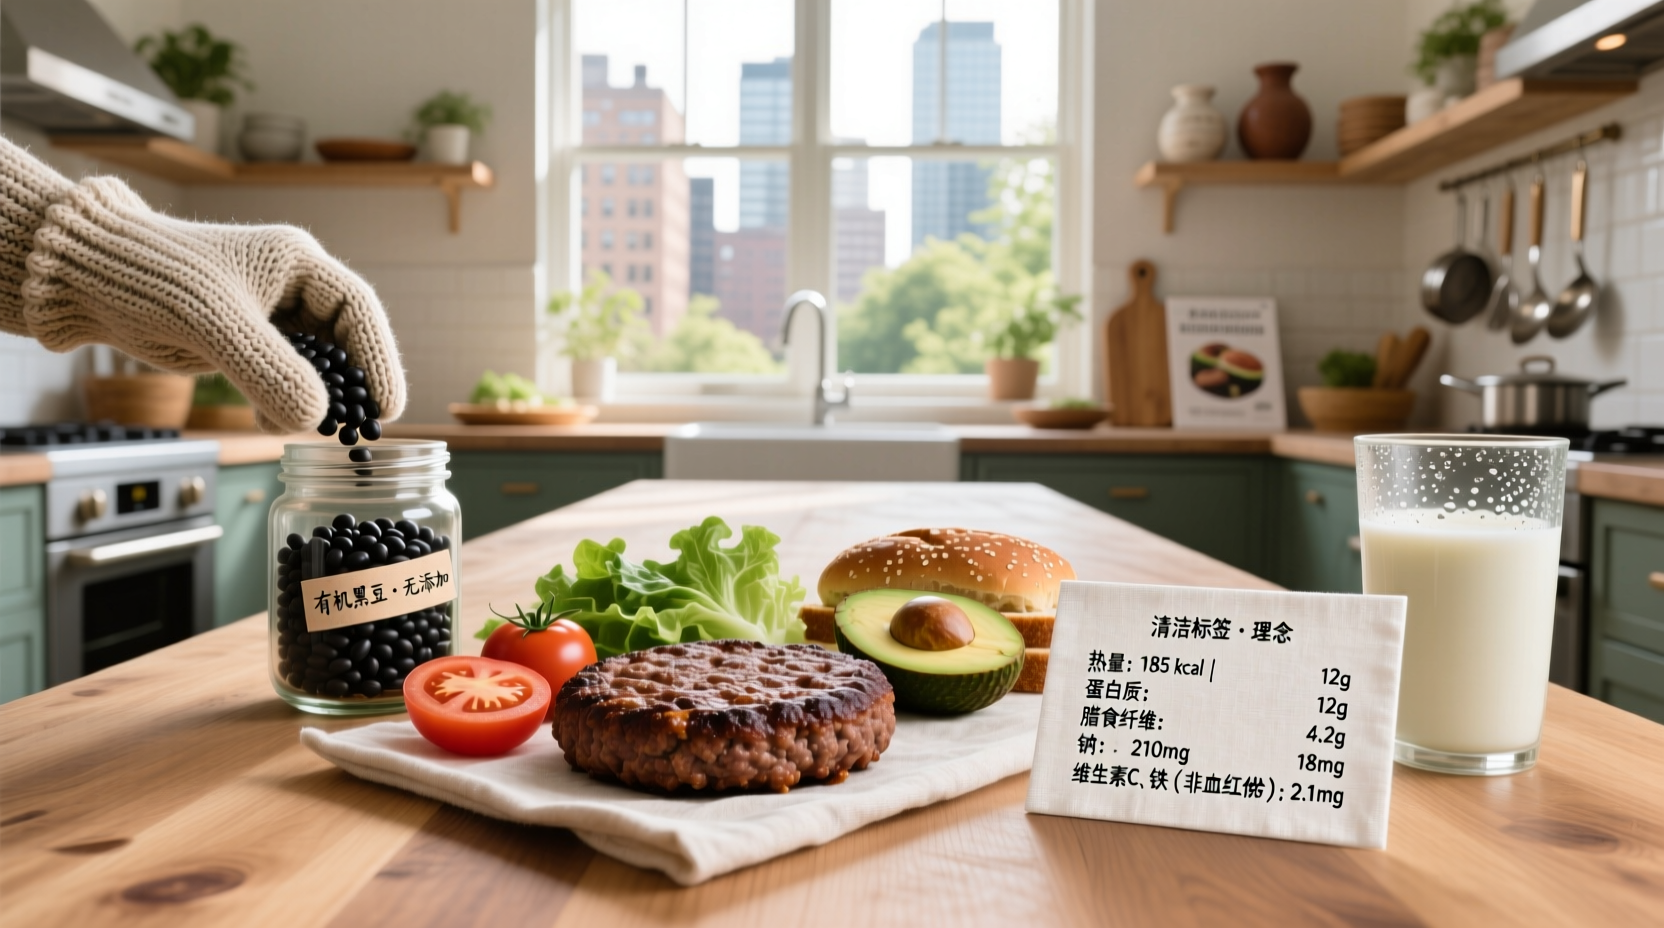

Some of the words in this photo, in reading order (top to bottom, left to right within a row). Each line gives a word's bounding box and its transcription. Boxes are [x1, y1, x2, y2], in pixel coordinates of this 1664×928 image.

[1140, 655, 1171, 674] 185
[1173, 657, 1205, 677] kcal
[1321, 667, 1351, 692] 12g
[1317, 696, 1349, 721] 12g
[1305, 724, 1346, 750] 4.2g
[1130, 738, 1191, 766] 210mg
[1297, 753, 1345, 779] 18mg
[1289, 782, 1344, 809] 2.1mg
